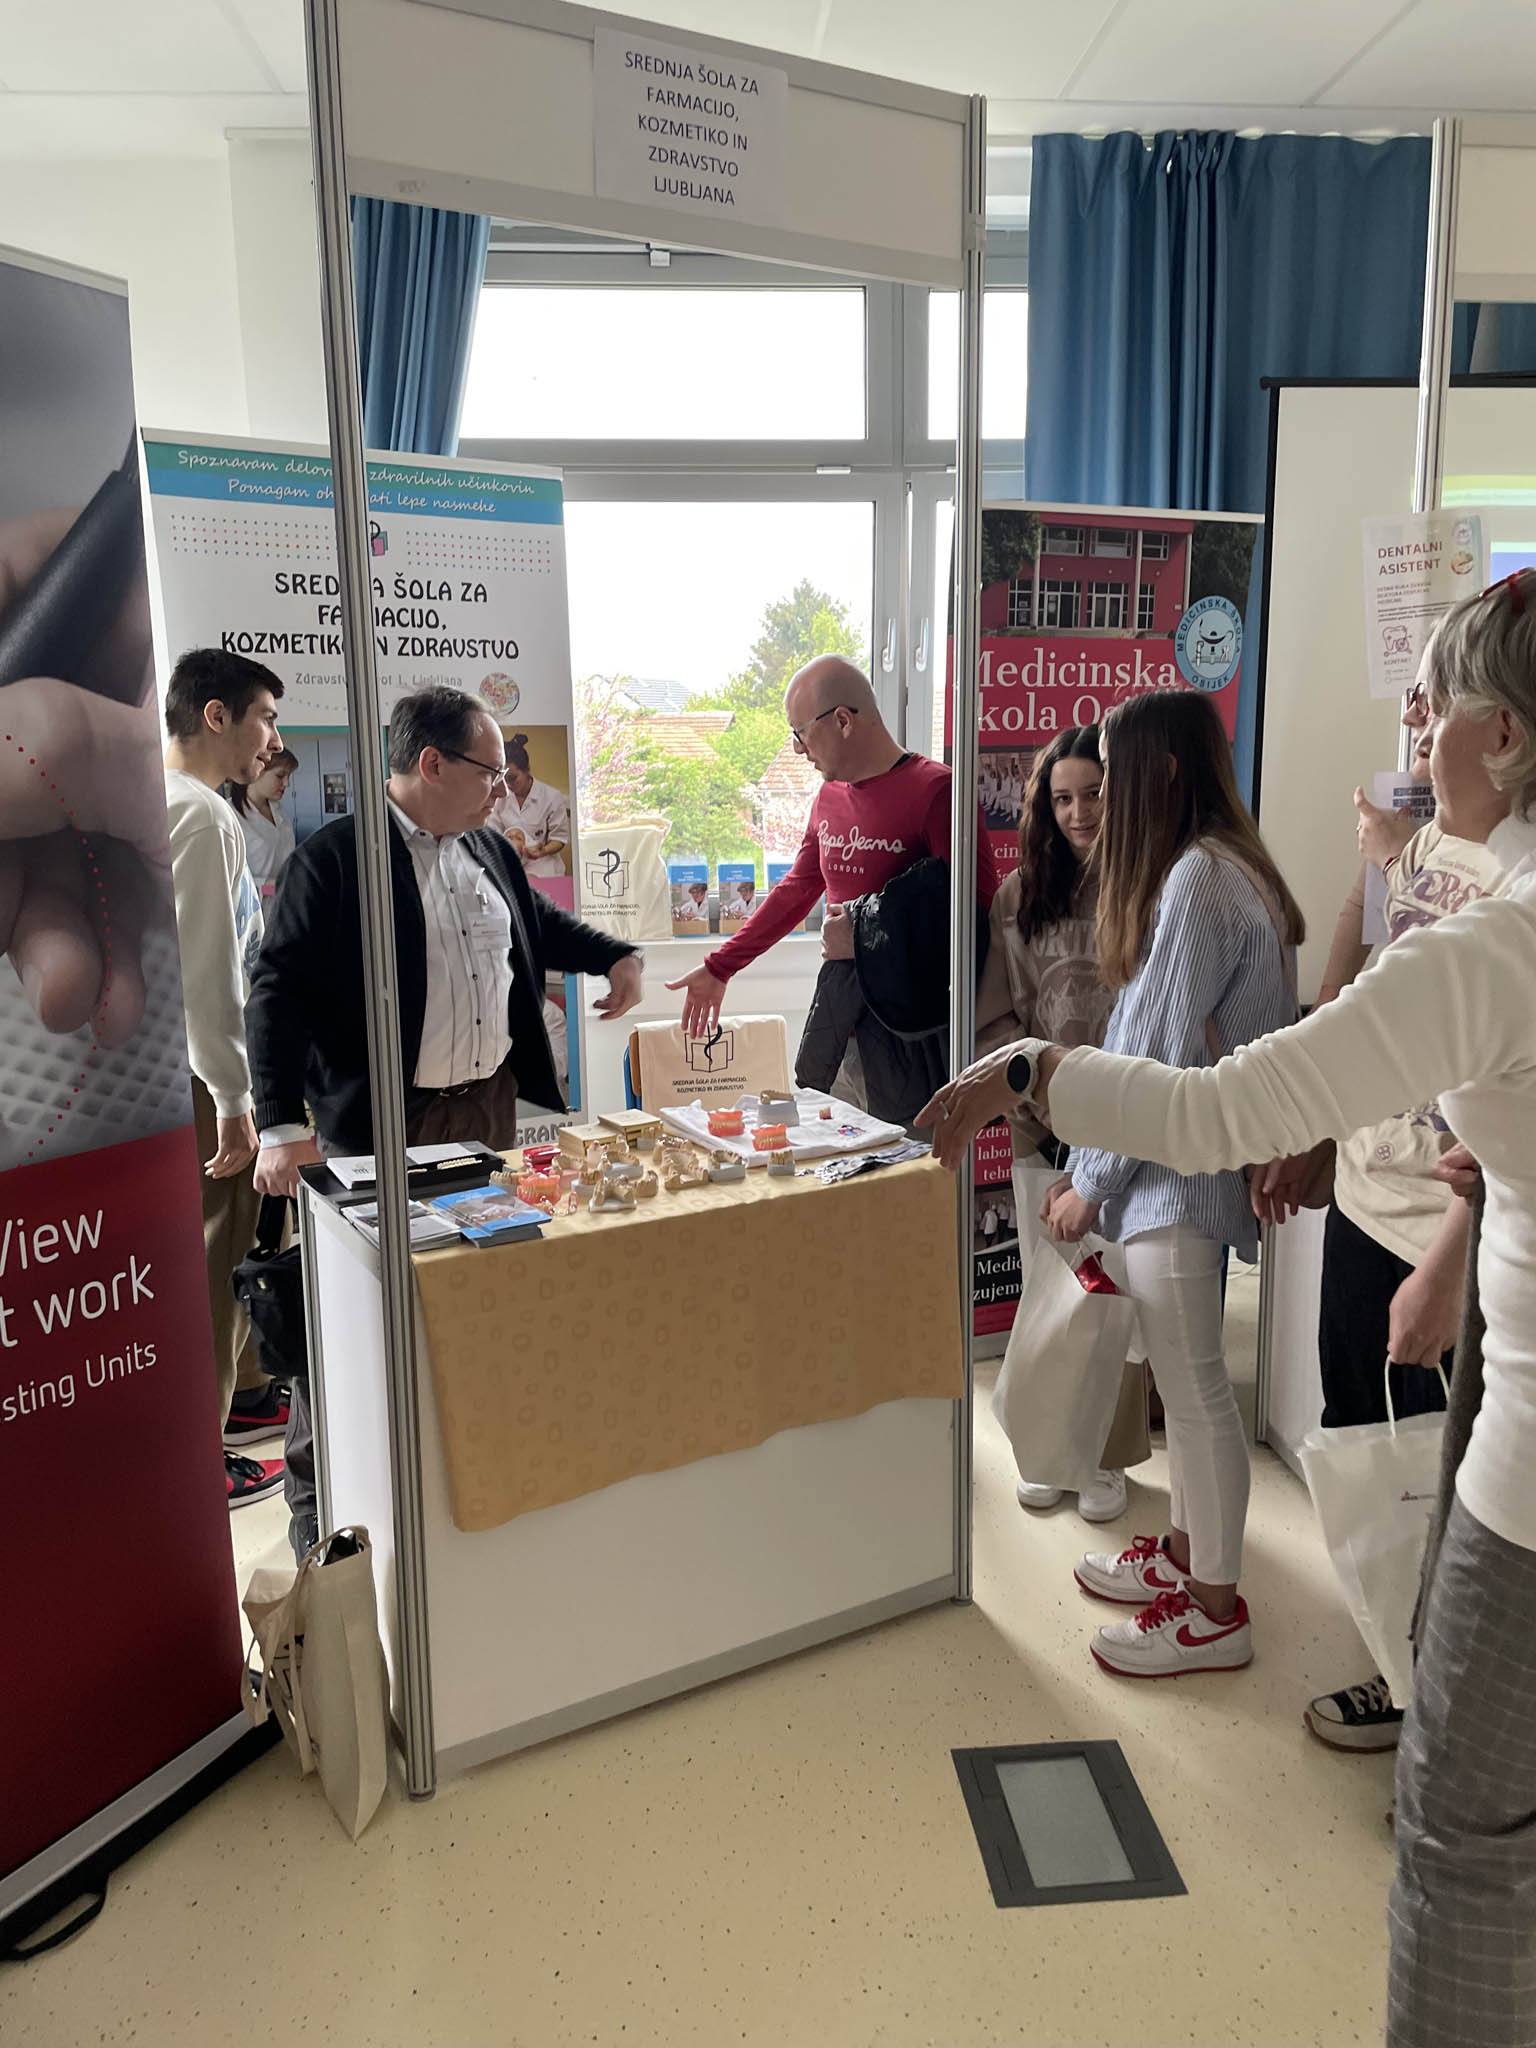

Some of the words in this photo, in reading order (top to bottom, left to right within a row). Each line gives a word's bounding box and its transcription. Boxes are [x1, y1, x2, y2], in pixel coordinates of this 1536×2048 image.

[624, 51, 694, 81] SREDNJA
[697, 64, 737, 91] ŠOLA
[740, 77, 759, 96] ZA
[646, 86, 740, 122] FARMACIJO,
[637, 114, 729, 147] KOZMETIKO
[732, 134, 748, 151] IN
[648, 146, 739, 177] ZDRAVSTVO
[654, 176, 735, 206] LJUBLJANA
[178, 449, 279, 472] Spoznavam
[285, 459, 333, 477] delov
[369, 467, 454, 487] zdravilnih
[457, 477, 535, 495] učinkovin
[228, 479, 310, 500] Pomagam
[397, 491, 427, 511] lepe
[433, 499, 496, 513] nasmehe
[1377, 540, 1443, 560] DENTALNI
[1378, 558, 1441, 576] ASISTENT
[393, 571, 452, 601] ŠOLA
[461, 581, 488, 603] ZA
[318, 604, 447, 631] FAACIJO,
[1176, 599, 1228, 652] MEDICINSKA
[221, 631, 345, 655] KOZMETIK
[397, 636, 519, 660] ZDRAVSTVO
[1191, 675, 1230, 689] OSIJEK
[978, 691, 1059, 732] kola
[817, 819, 845, 857] Pepe
[842, 825, 907, 861] Jeans
[828, 863, 865, 875] LONDON
[33, 1255, 155, 1335] work
[2, 1373, 77, 1422] sting
[85, 1341, 158, 1388] Units
